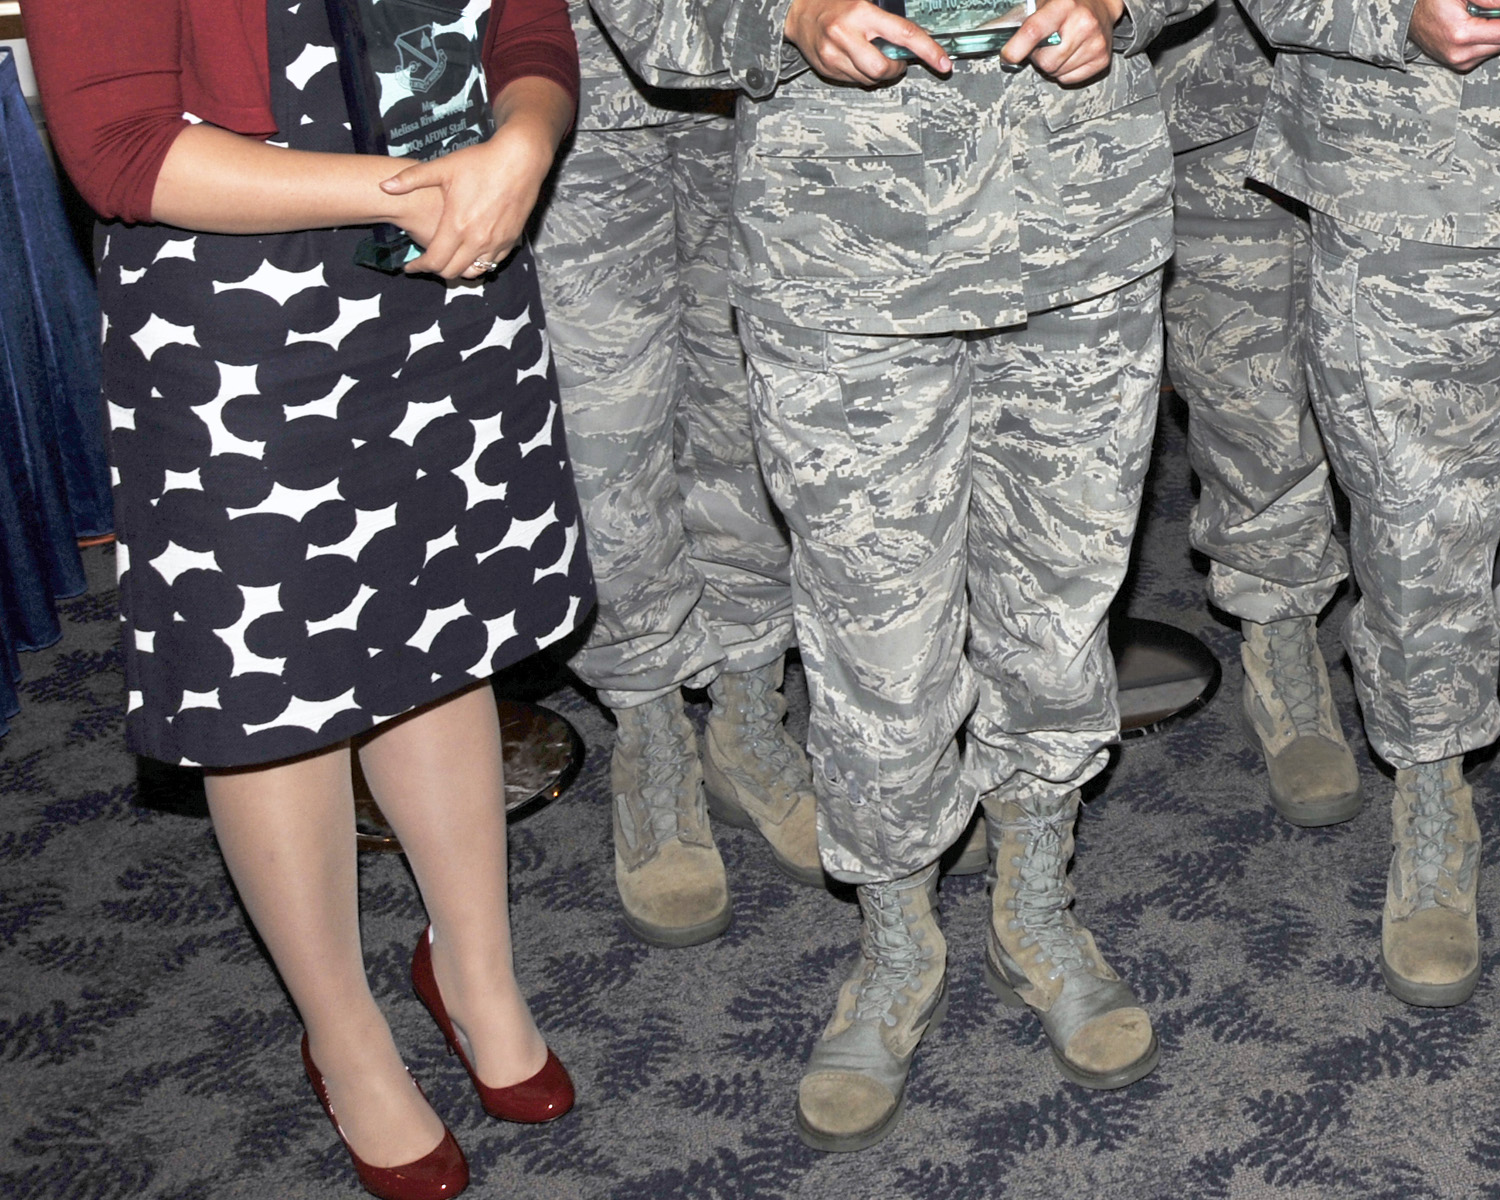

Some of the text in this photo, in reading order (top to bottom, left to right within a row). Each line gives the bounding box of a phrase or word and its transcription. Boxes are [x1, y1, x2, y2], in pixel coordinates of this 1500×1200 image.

[390, 120, 421, 140] Melissa
[424, 126, 448, 146] AFDW
[448, 118, 468, 135] Staff
